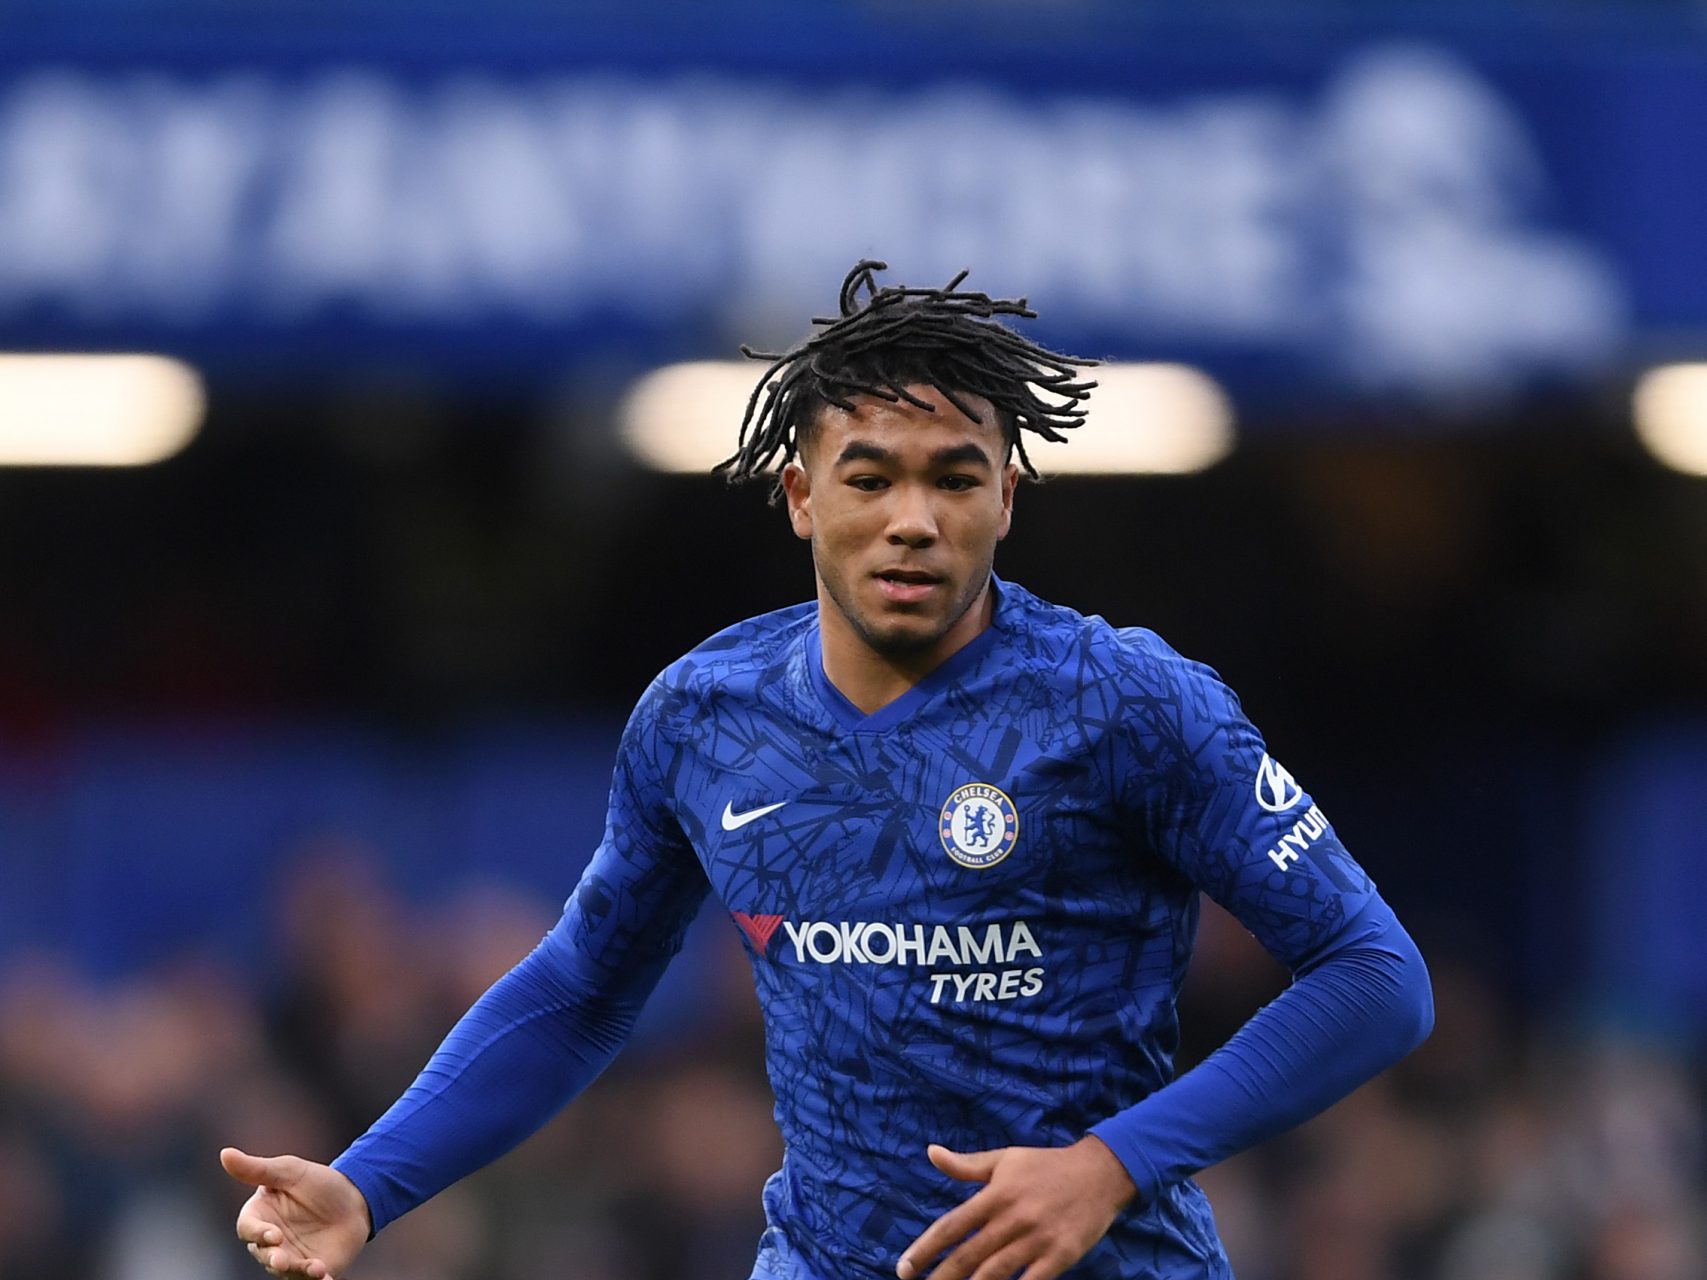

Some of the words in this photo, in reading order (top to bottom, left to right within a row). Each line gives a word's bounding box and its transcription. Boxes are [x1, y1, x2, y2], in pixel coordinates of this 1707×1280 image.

[953, 787, 1004, 806] CHELSEA
[951, 846, 984, 863] FOOTBALL
[784, 920, 1043, 966] YOKOHAMA
[929, 967, 1045, 1004] TYRES
